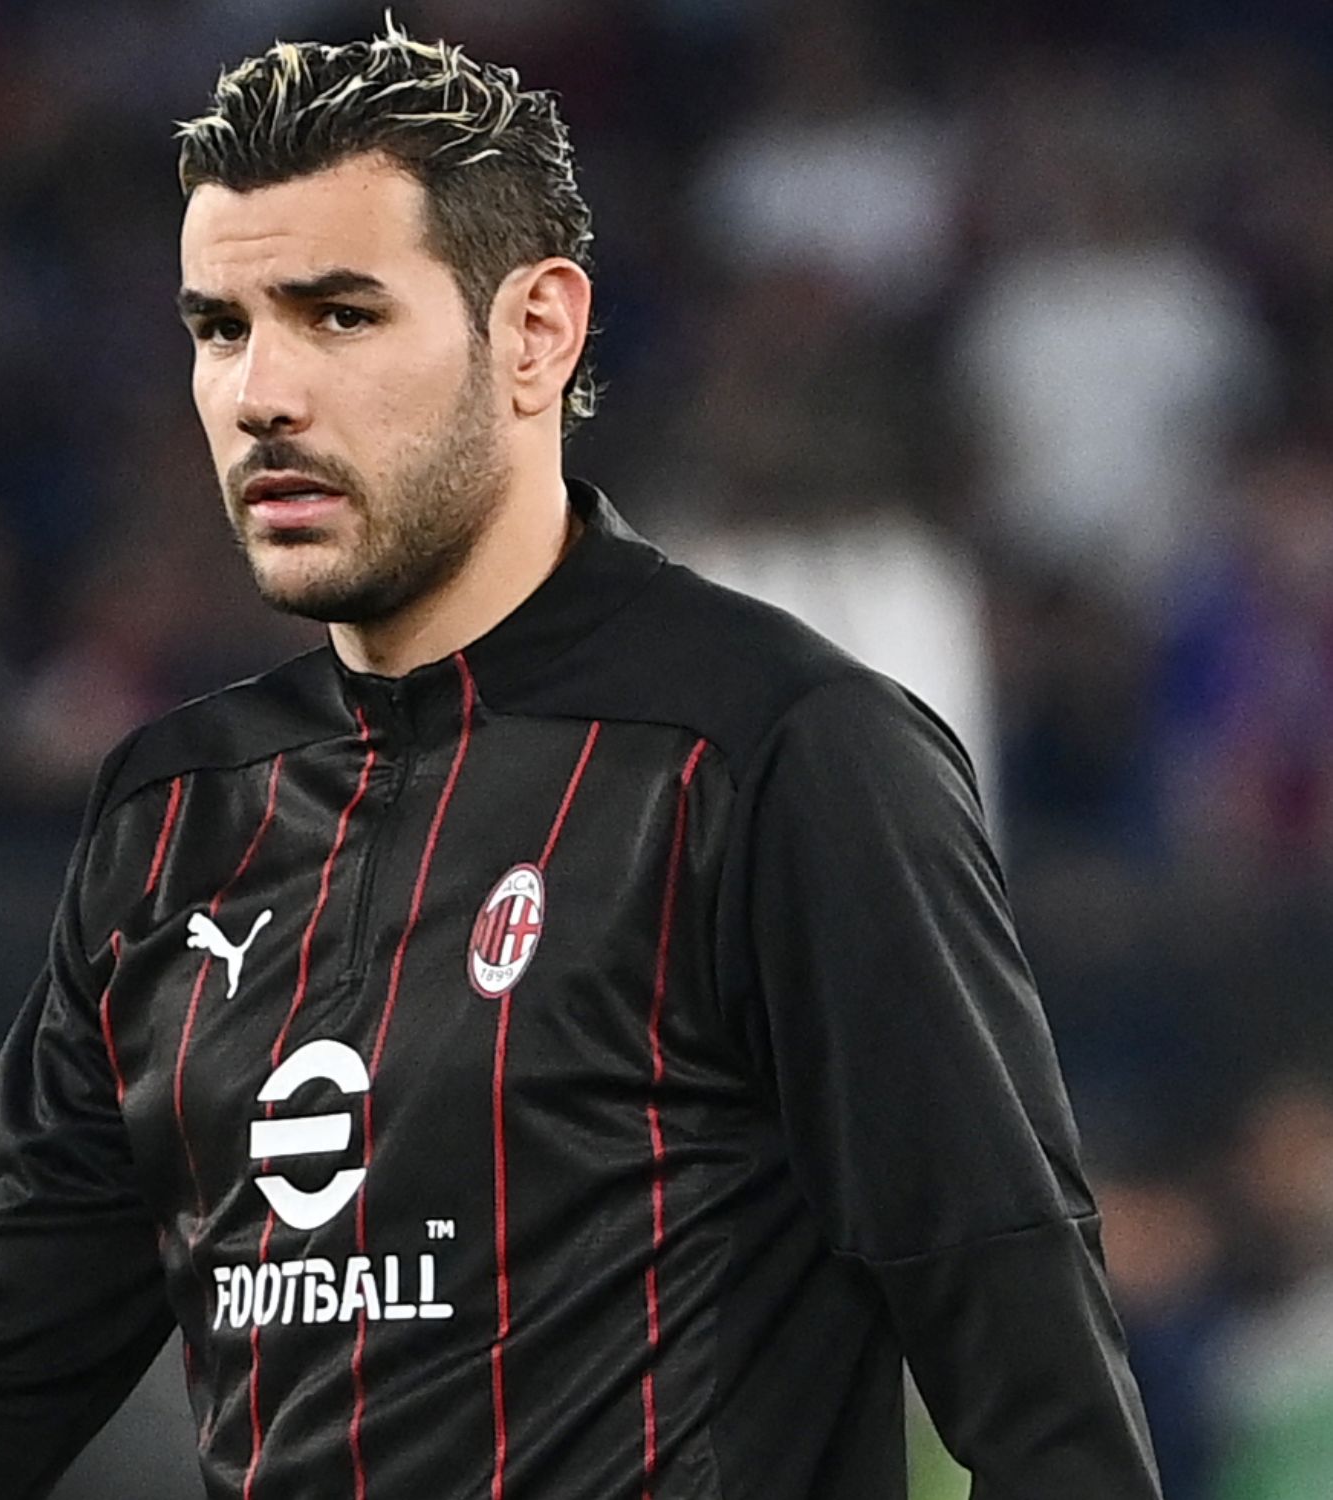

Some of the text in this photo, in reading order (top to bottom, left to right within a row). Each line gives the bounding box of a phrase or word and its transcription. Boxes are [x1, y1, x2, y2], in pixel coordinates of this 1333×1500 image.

[480, 966, 514, 982] 1899
[425, 1219, 455, 1239] TM
[213, 1254, 454, 1330] FOOTBALL
